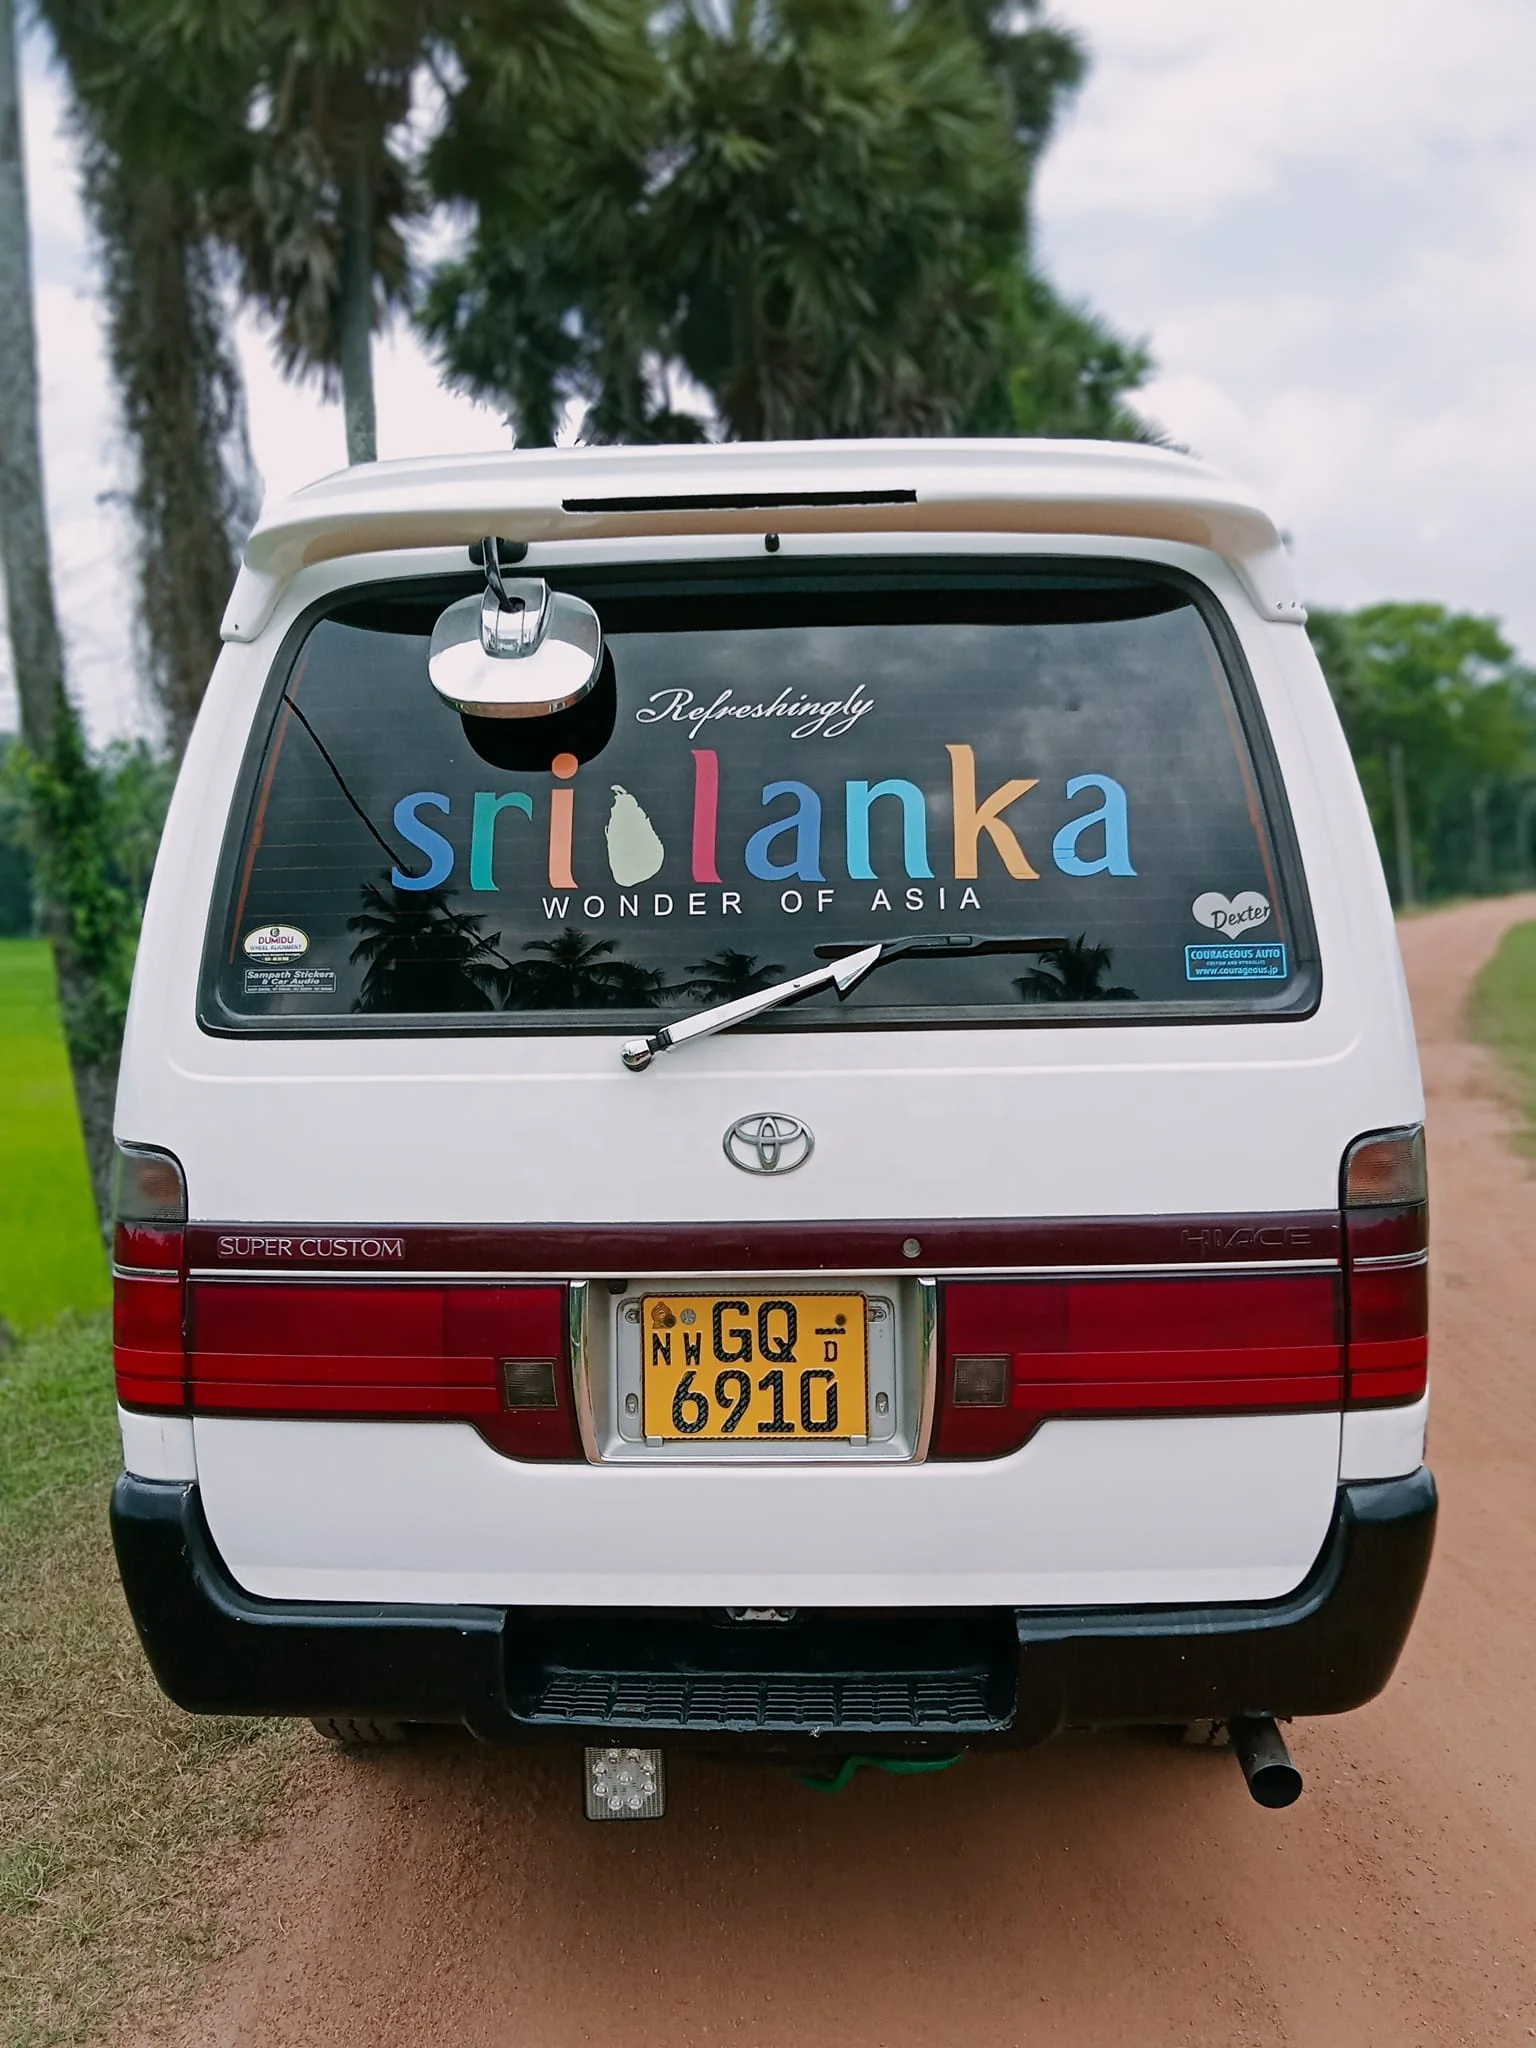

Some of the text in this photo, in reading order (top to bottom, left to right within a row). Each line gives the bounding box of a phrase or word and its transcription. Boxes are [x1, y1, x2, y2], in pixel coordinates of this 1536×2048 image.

[636, 683, 874, 739] Refreshingly
[391, 744, 1139, 892] sri lanka
[542, 887, 981, 919] WONDER OF ASIA
[1211, 905, 1271, 930] Dexter
[258, 936, 294, 945] DUMIDU
[1190, 948, 1281, 960] COURAGEOUS AUTO
[247, 970, 335, 981] Sampath Stickers
[289, 977, 321, 985] Audio
[1194, 964, 1279, 976] www.courageous.jp
[219, 1238, 402, 1257] SUPER CUSTOM
[1181, 1226, 1311, 1249] HIACE
[712, 1300, 798, 1363] GQ
[823, 1340, 838, 1362] D
[671, 1369, 838, 1434] 6910
